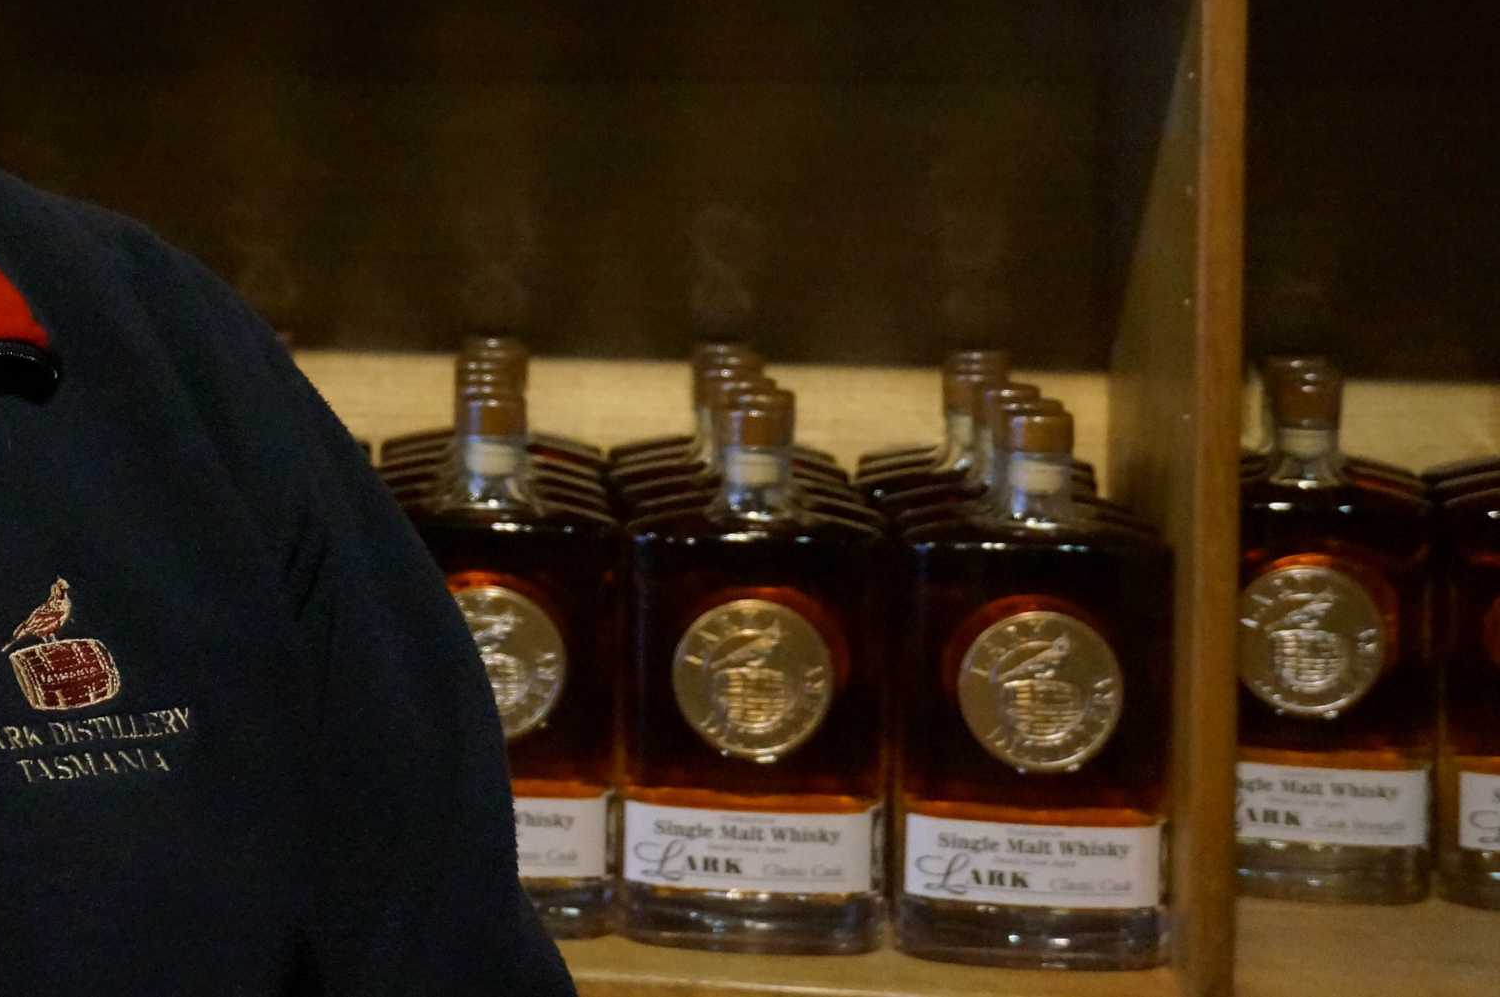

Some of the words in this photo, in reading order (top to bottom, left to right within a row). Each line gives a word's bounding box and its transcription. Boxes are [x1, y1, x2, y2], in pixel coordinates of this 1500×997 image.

[48, 706, 190, 746] DISTILLERY
[16, 748, 171, 783] TASMANIA
[653, 818, 713, 844] Single
[719, 823, 764, 842] Malt
[770, 826, 841, 846] Whisky
[936, 831, 999, 854] Single
[1005, 837, 1053, 855] Malt
[1058, 840, 1132, 860] Whisky
[633, 838, 743, 882] LARK
[913, 852, 1029, 894] LARK
